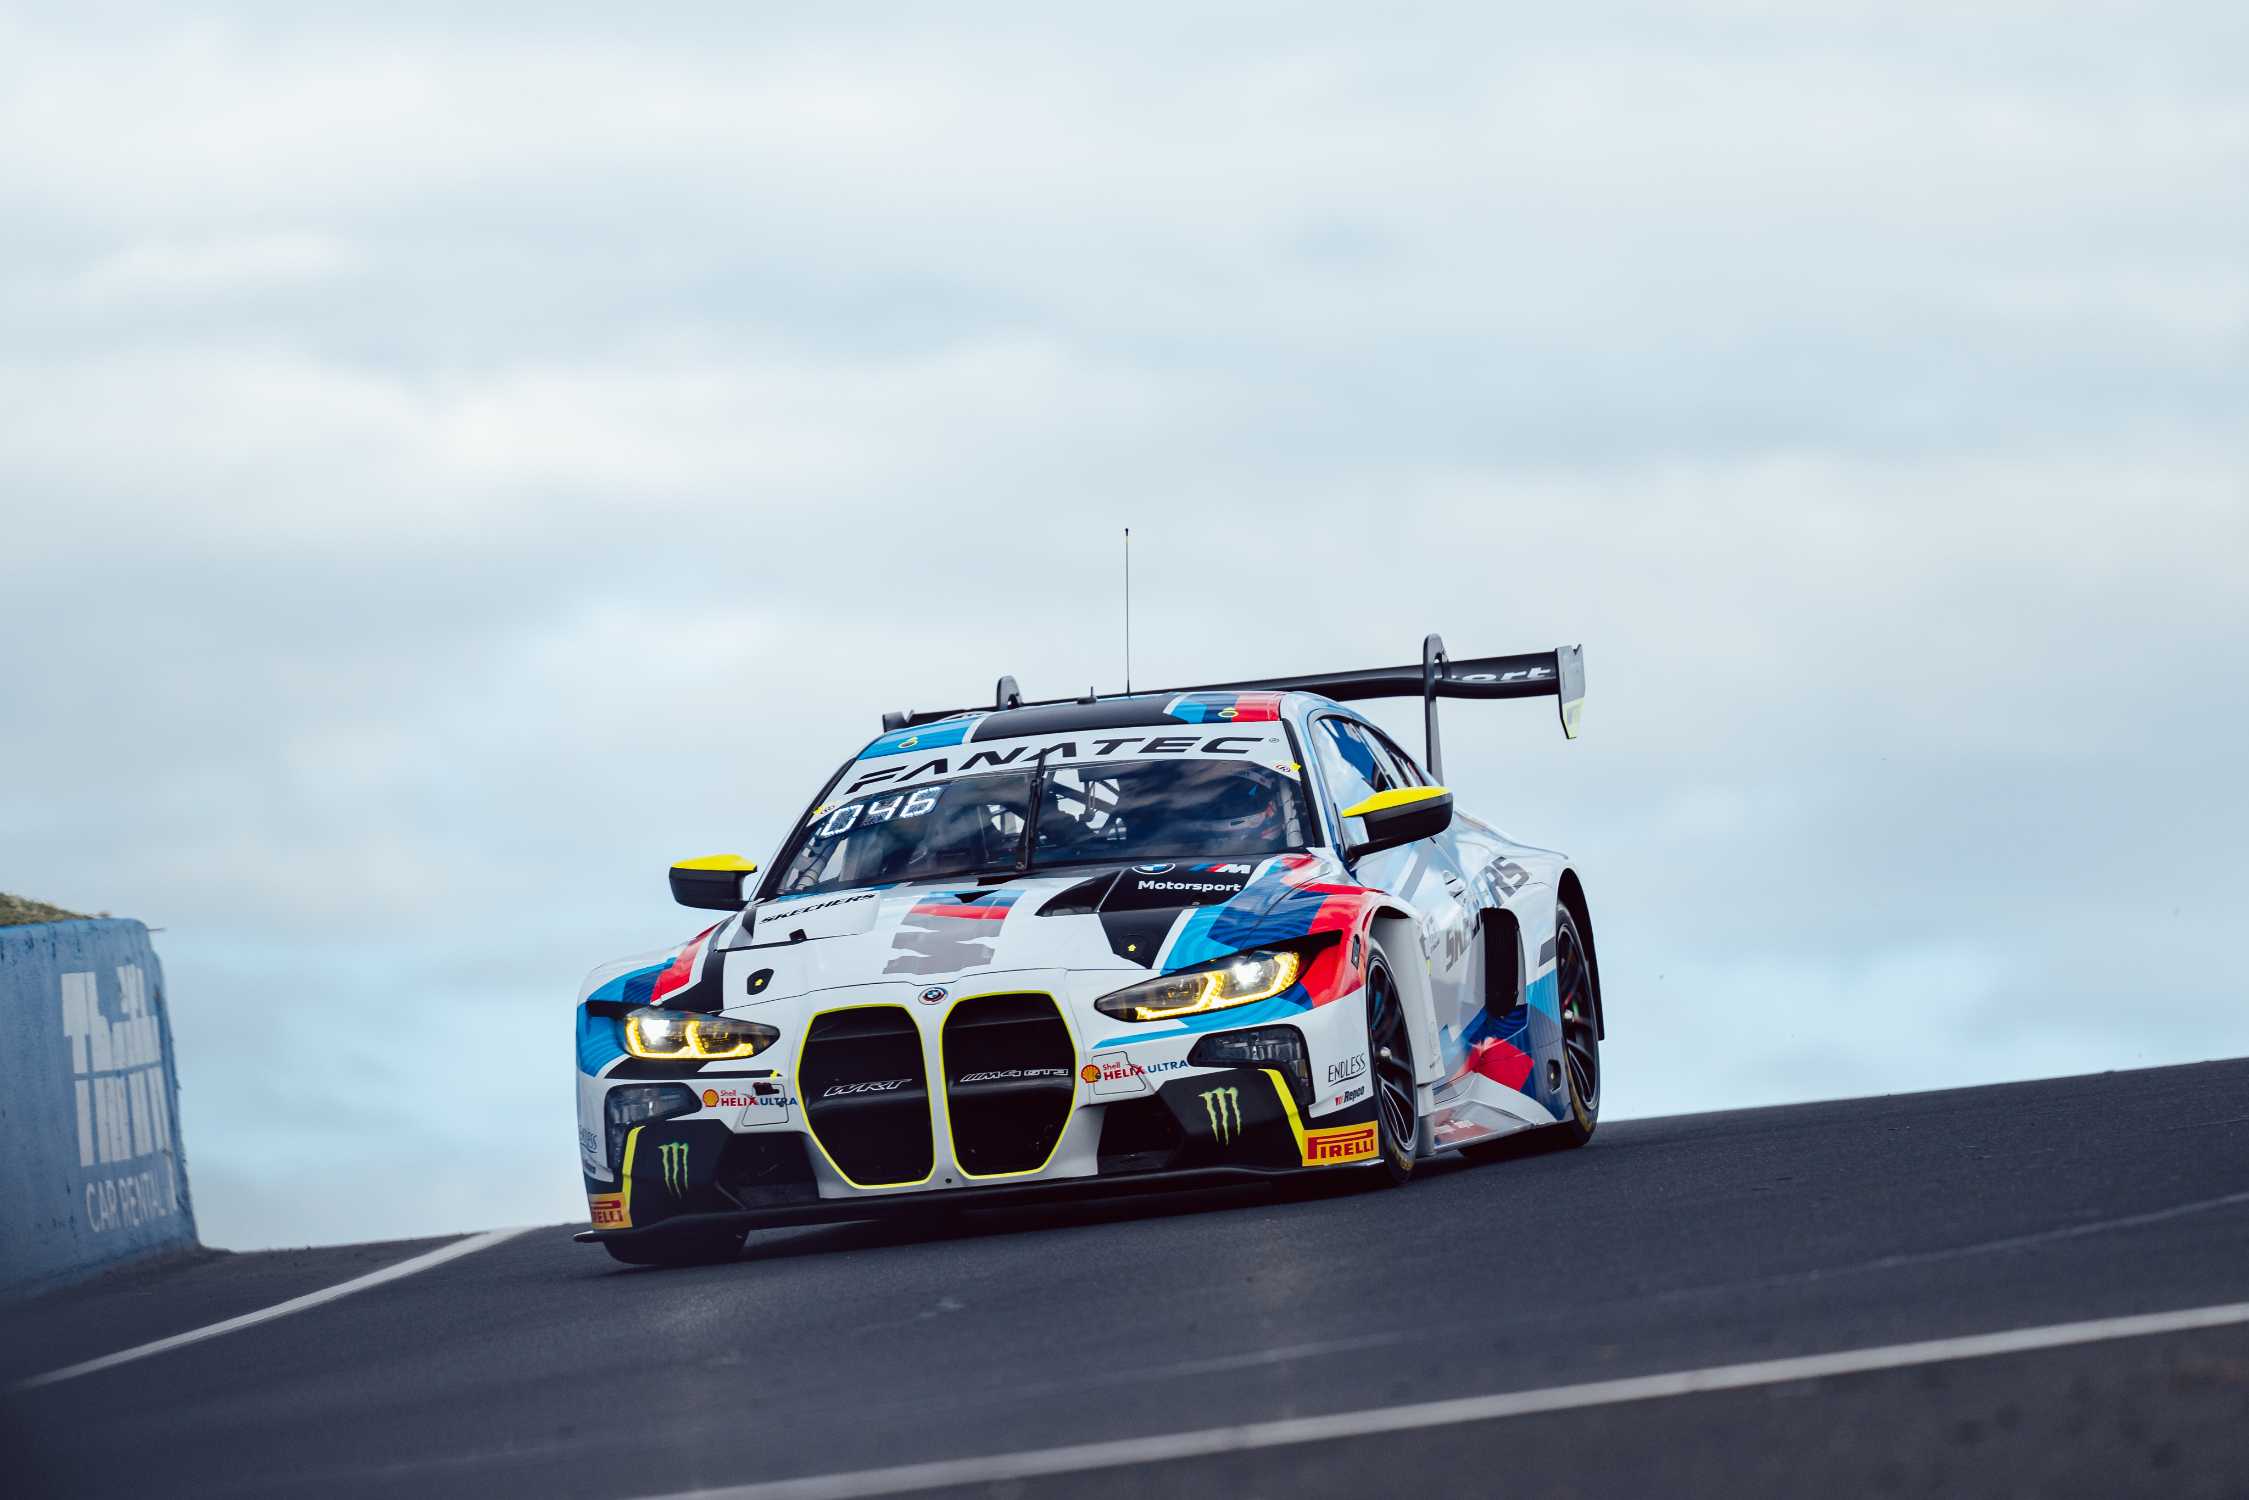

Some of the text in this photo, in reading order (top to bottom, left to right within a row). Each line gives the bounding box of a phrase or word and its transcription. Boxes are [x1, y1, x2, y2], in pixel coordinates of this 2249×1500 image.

[844, 737, 1264, 795] FANATEC
[820, 786, 942, 837] 046
[1137, 880, 1242, 892] Motorsport
[760, 894, 875, 924] SKECHERS
[1103, 1061, 1121, 1071] Shell
[1103, 1060, 1188, 1081] HELIX ULTRA
[1328, 1053, 1367, 1083] ENDLESS
[720, 1096, 798, 1107] HELIX ULTRA
[1344, 1086, 1365, 1103] Repco
[1307, 1129, 1374, 1159] PIRELLI
